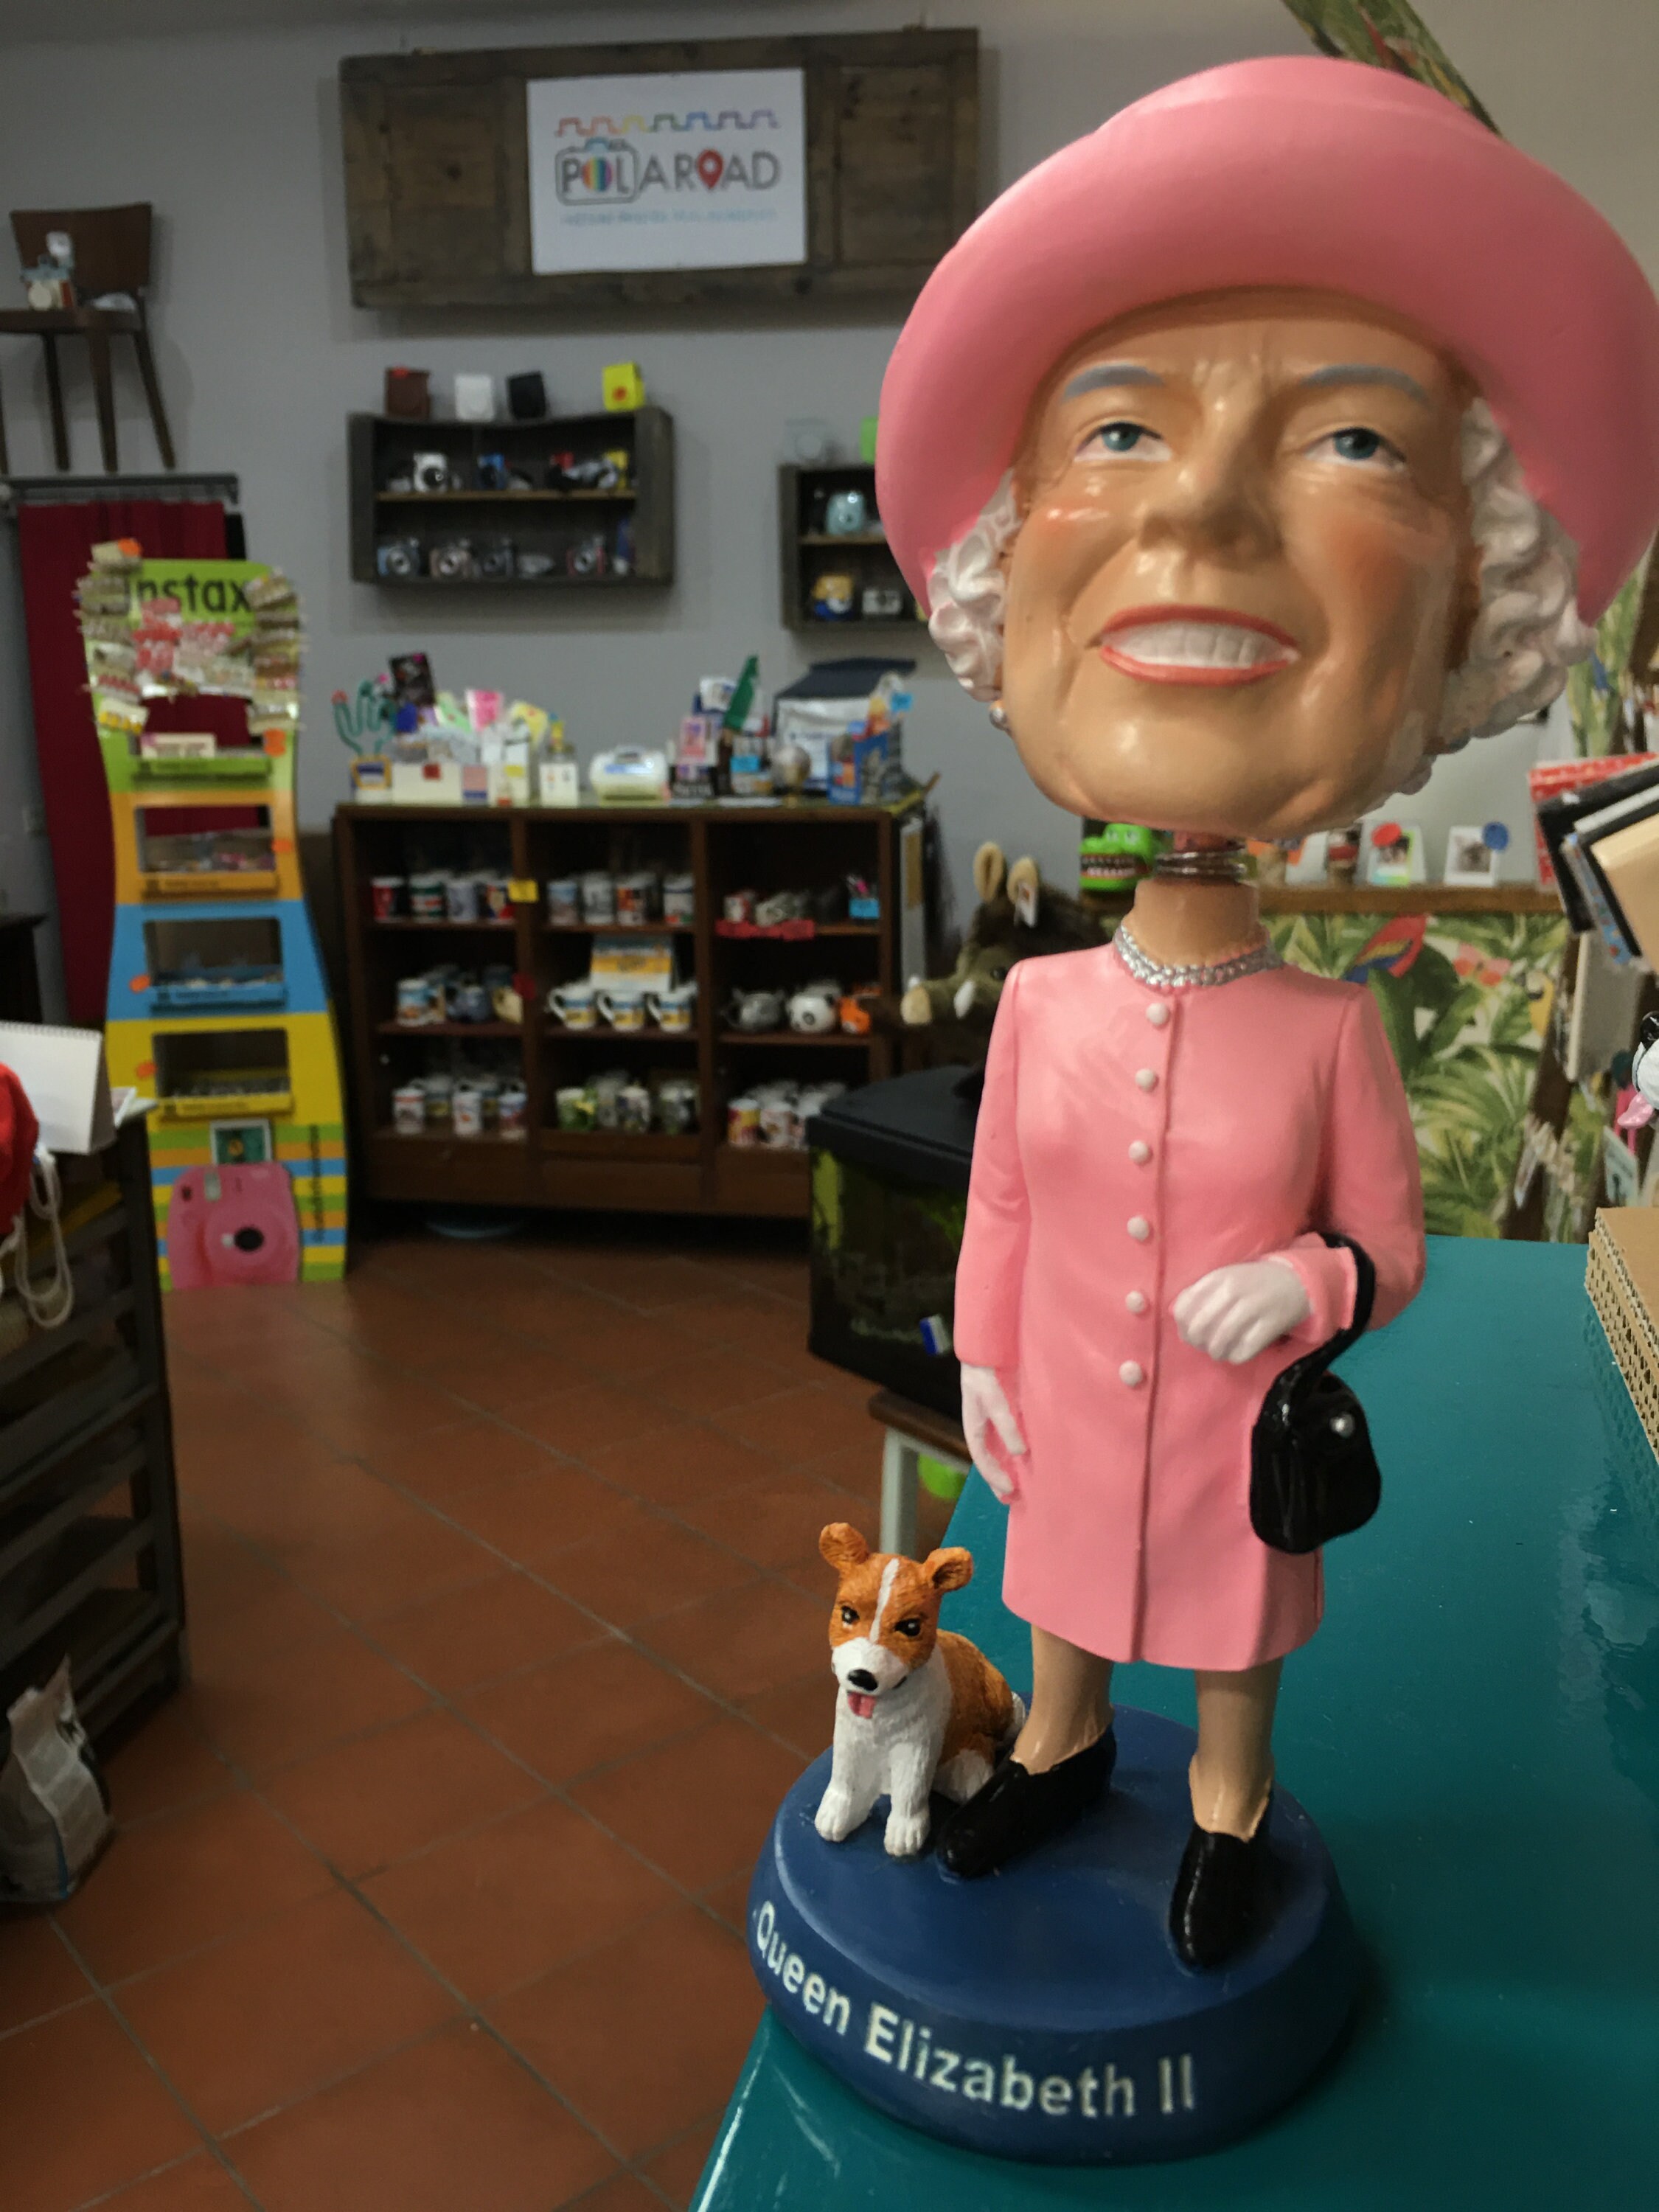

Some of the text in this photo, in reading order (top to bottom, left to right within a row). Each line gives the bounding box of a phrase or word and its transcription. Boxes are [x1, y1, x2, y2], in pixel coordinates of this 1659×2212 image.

[560, 147, 782, 195] POLAROAD
[755, 1900, 852, 2036] Queen
[863, 2000, 1135, 2118] Elizabeth
